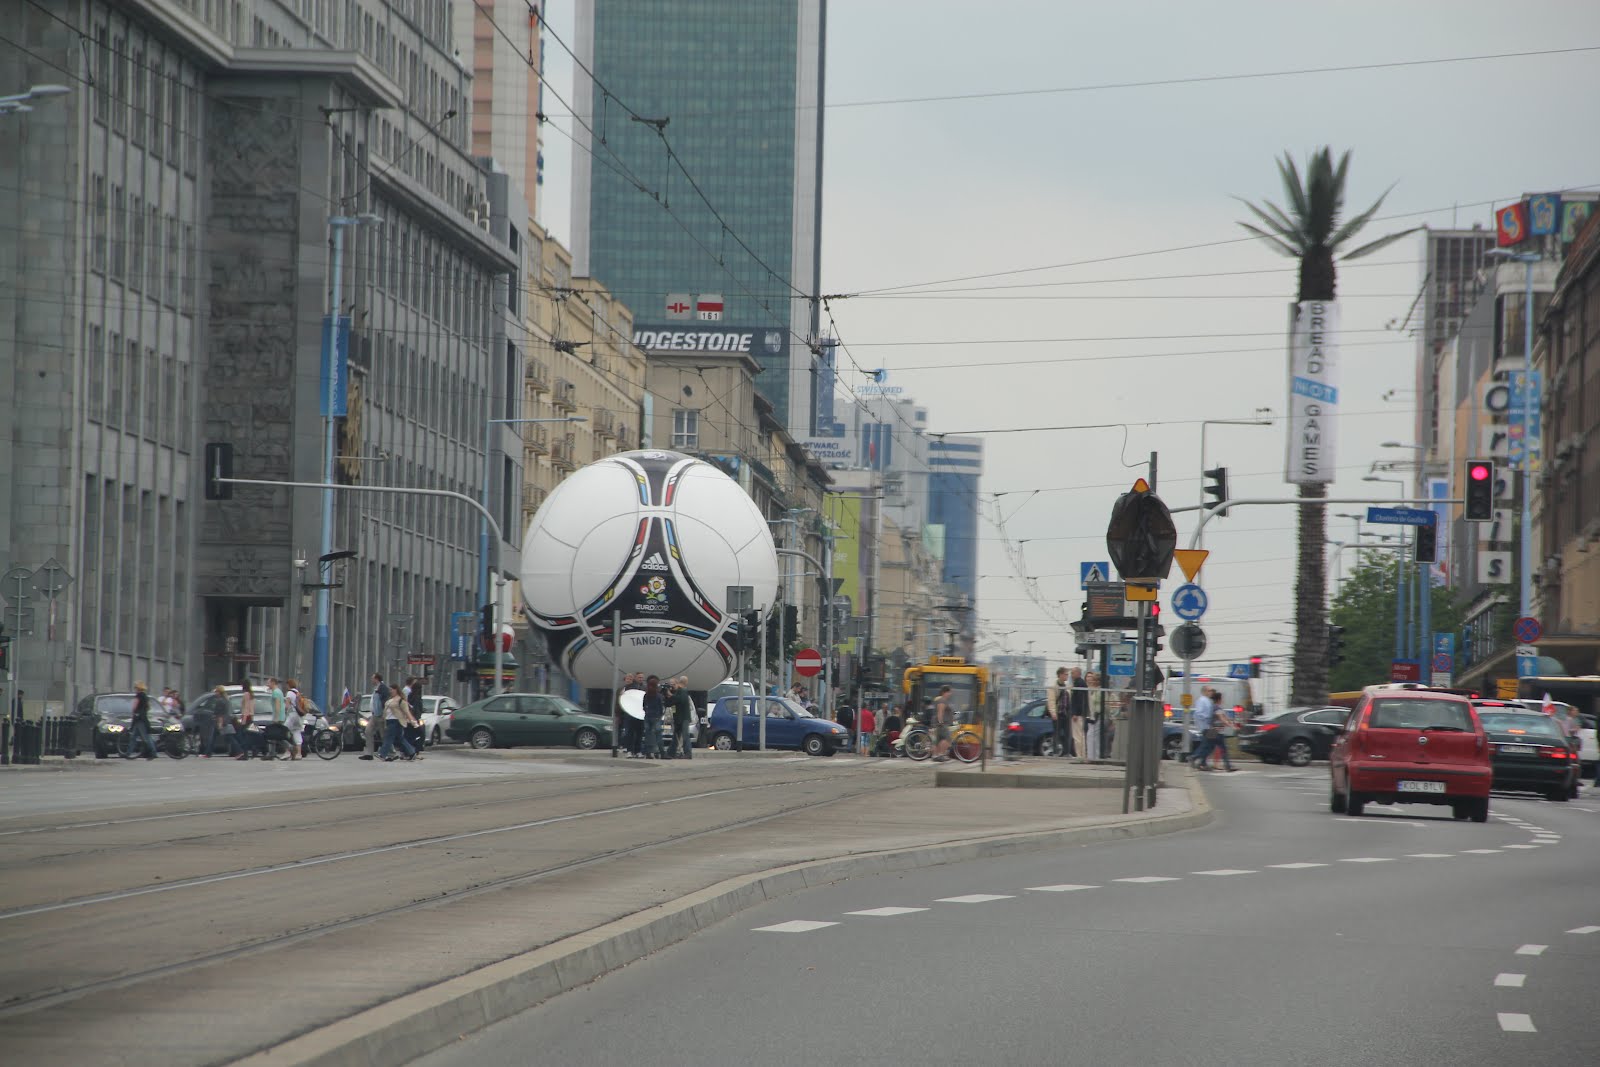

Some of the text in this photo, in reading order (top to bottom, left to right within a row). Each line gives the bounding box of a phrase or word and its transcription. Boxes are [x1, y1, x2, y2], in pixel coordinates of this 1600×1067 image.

[702, 312, 718, 320] 161
[1307, 303, 1325, 375] BREAD
[1295, 381, 1334, 402] NOT
[1302, 404, 1321, 475] GAMES
[641, 563, 669, 571] adidas
[630, 636, 676, 648] TANGO 12
